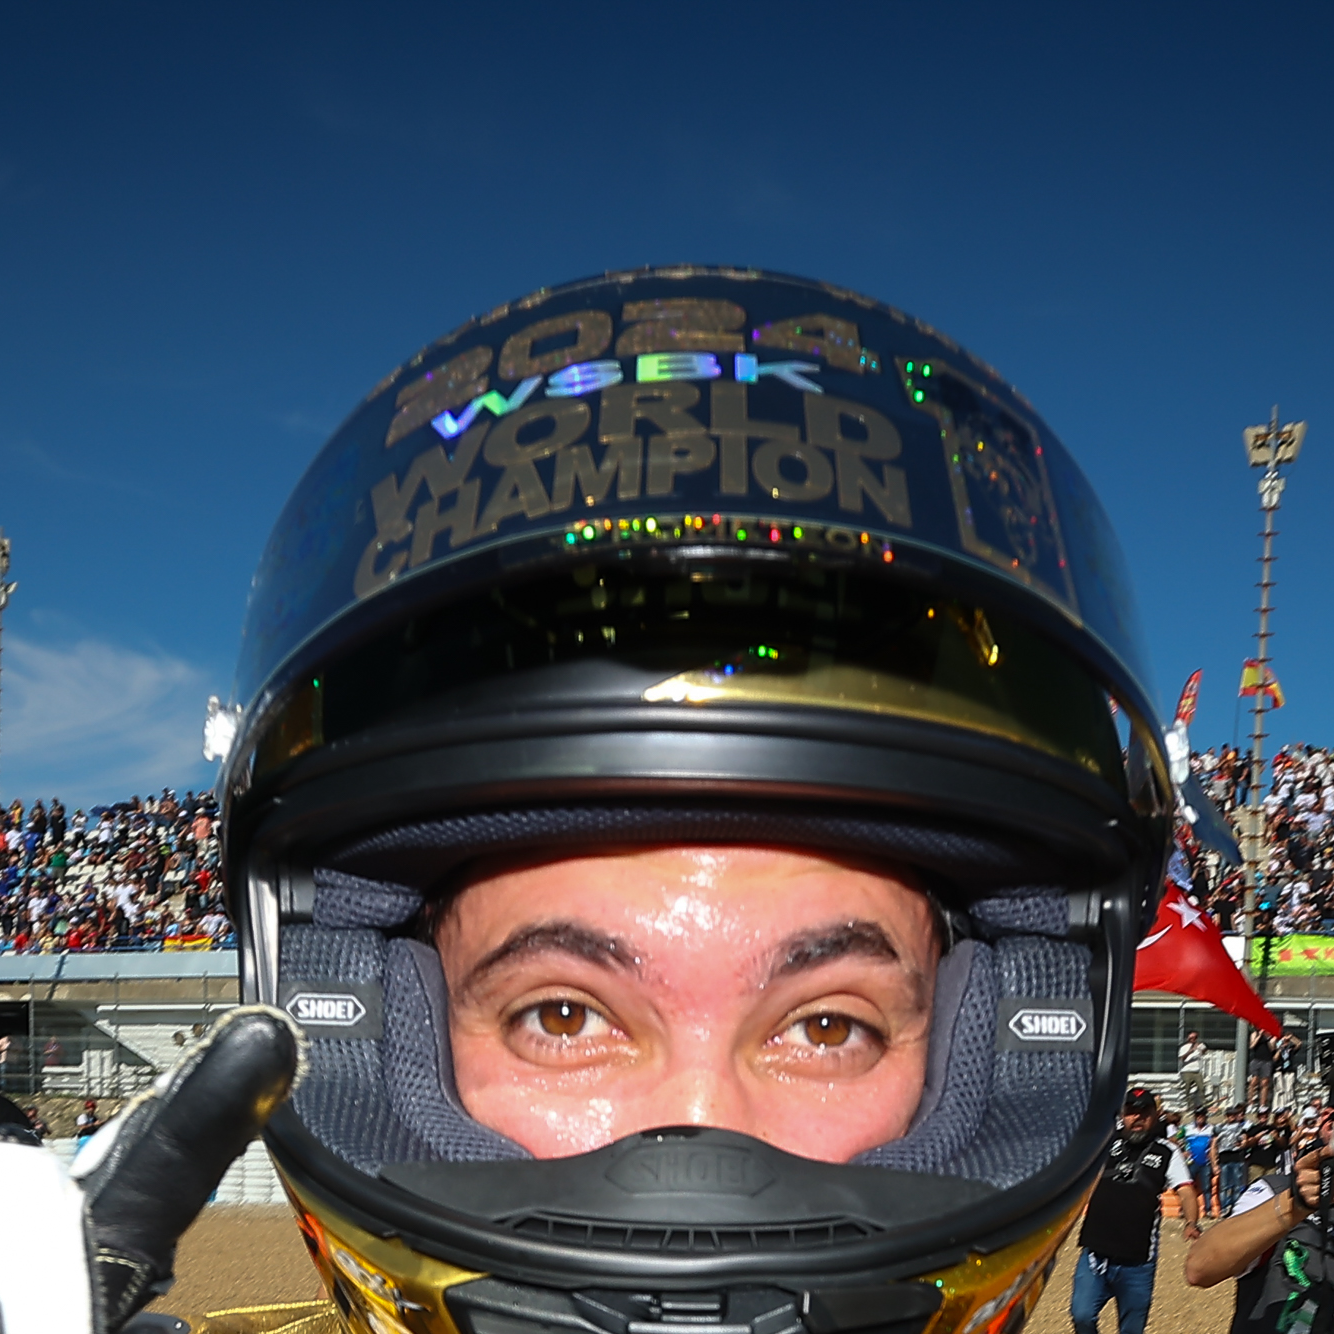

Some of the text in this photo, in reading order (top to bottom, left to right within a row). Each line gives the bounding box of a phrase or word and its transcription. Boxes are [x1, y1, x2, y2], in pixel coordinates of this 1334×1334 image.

[384, 297, 881, 447] 2024
[431, 351, 825, 440] WSBK
[354, 433, 912, 600] CHAMPION
[370, 380, 903, 536] WORLD
[297, 999, 355, 1019] SHOEI
[1021, 1015, 1077, 1035] SHOEI
